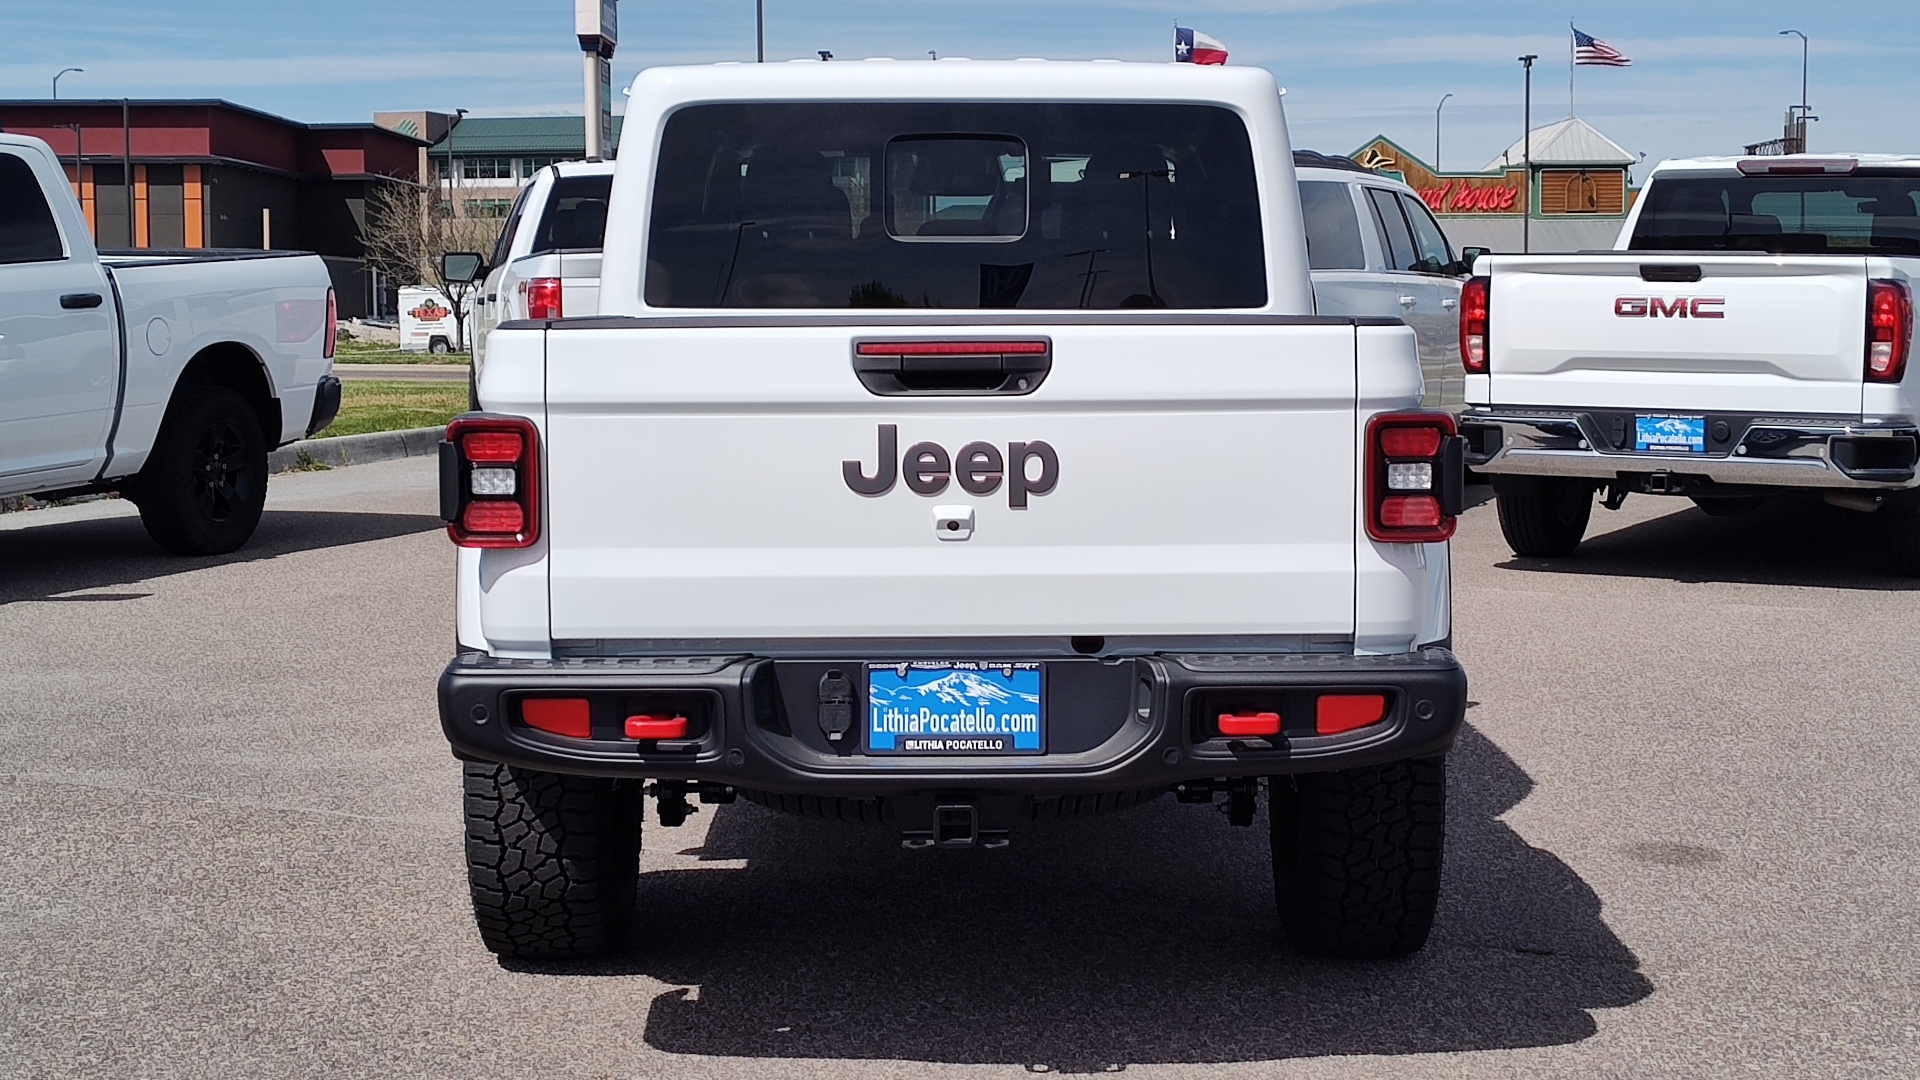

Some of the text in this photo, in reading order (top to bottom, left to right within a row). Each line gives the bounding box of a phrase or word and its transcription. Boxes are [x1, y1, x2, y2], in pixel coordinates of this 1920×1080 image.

[1449, 179, 1518, 210] house
[415, 307, 446, 318] TEXAS
[1614, 297, 1725, 319] GMC
[842, 424, 1060, 511] Jeep
[872, 706, 1037, 733] LithiaPocatello.com
[914, 740, 1003, 750] LITHIA POCATELLO
